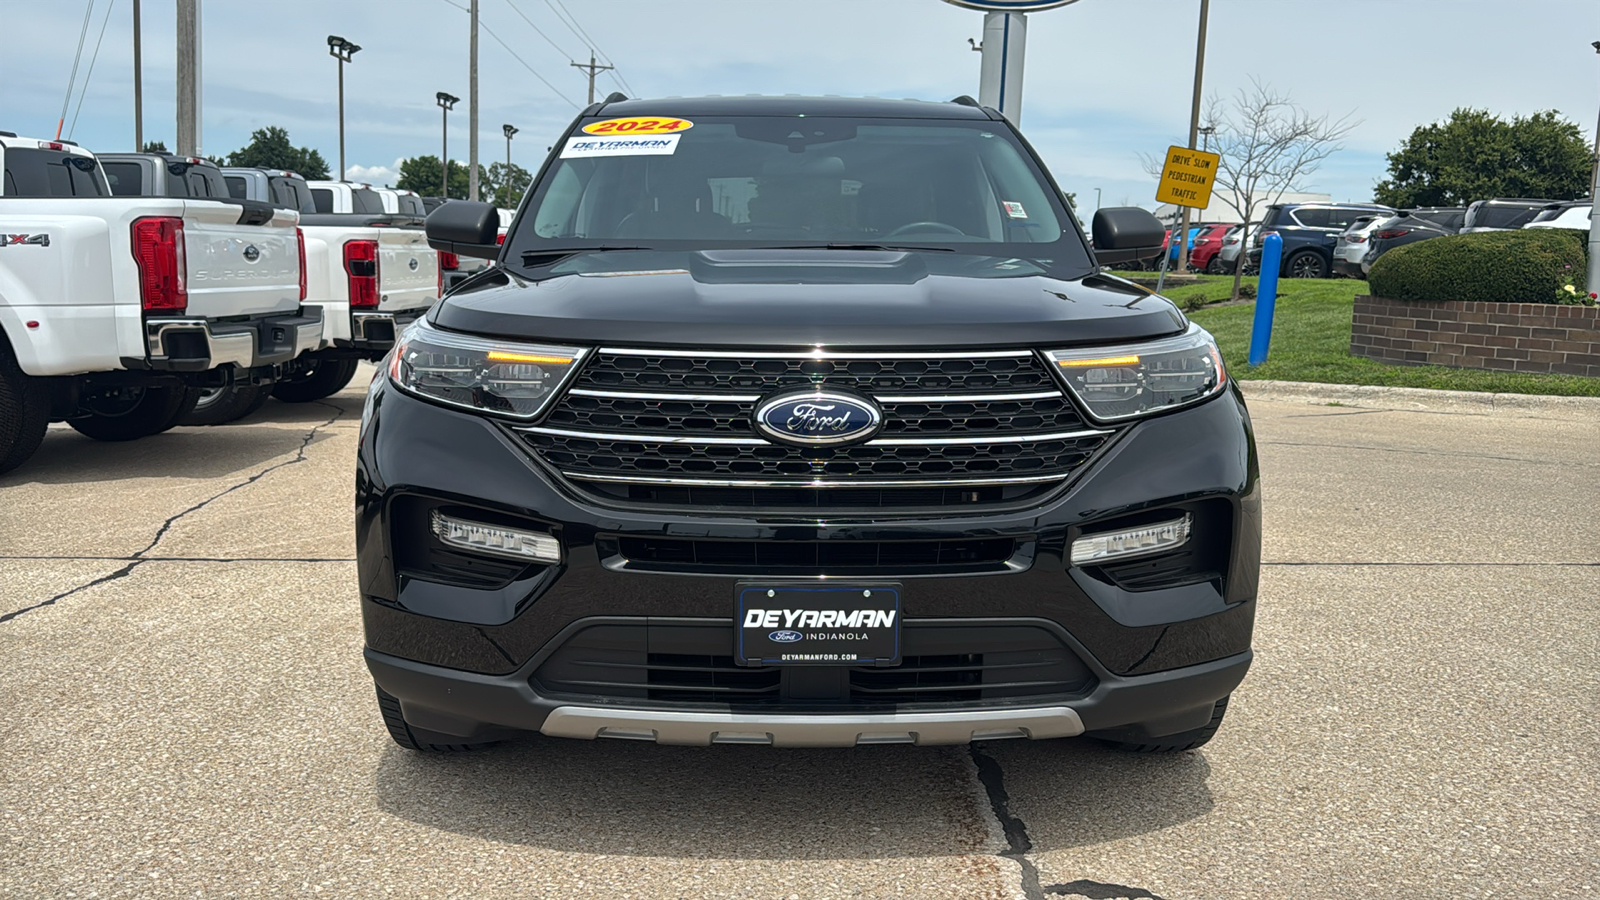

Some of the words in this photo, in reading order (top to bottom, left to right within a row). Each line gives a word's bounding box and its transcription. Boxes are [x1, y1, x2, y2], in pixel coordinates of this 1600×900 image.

[593, 120, 684, 133] 2024
[572, 140, 672, 149] DEYARMAN
[1172, 154, 1191, 166] DRIVE
[1193, 157, 1211, 169] SLOW
[1168, 170, 1207, 185] PEDESTRIAN
[1171, 187, 1197, 200] TRAFFIC
[786, 403, 852, 431] Ford
[743, 609, 896, 628] DEYARMAN
[775, 631, 796, 641] Ford
[806, 632, 869, 640] INDIANOLA
